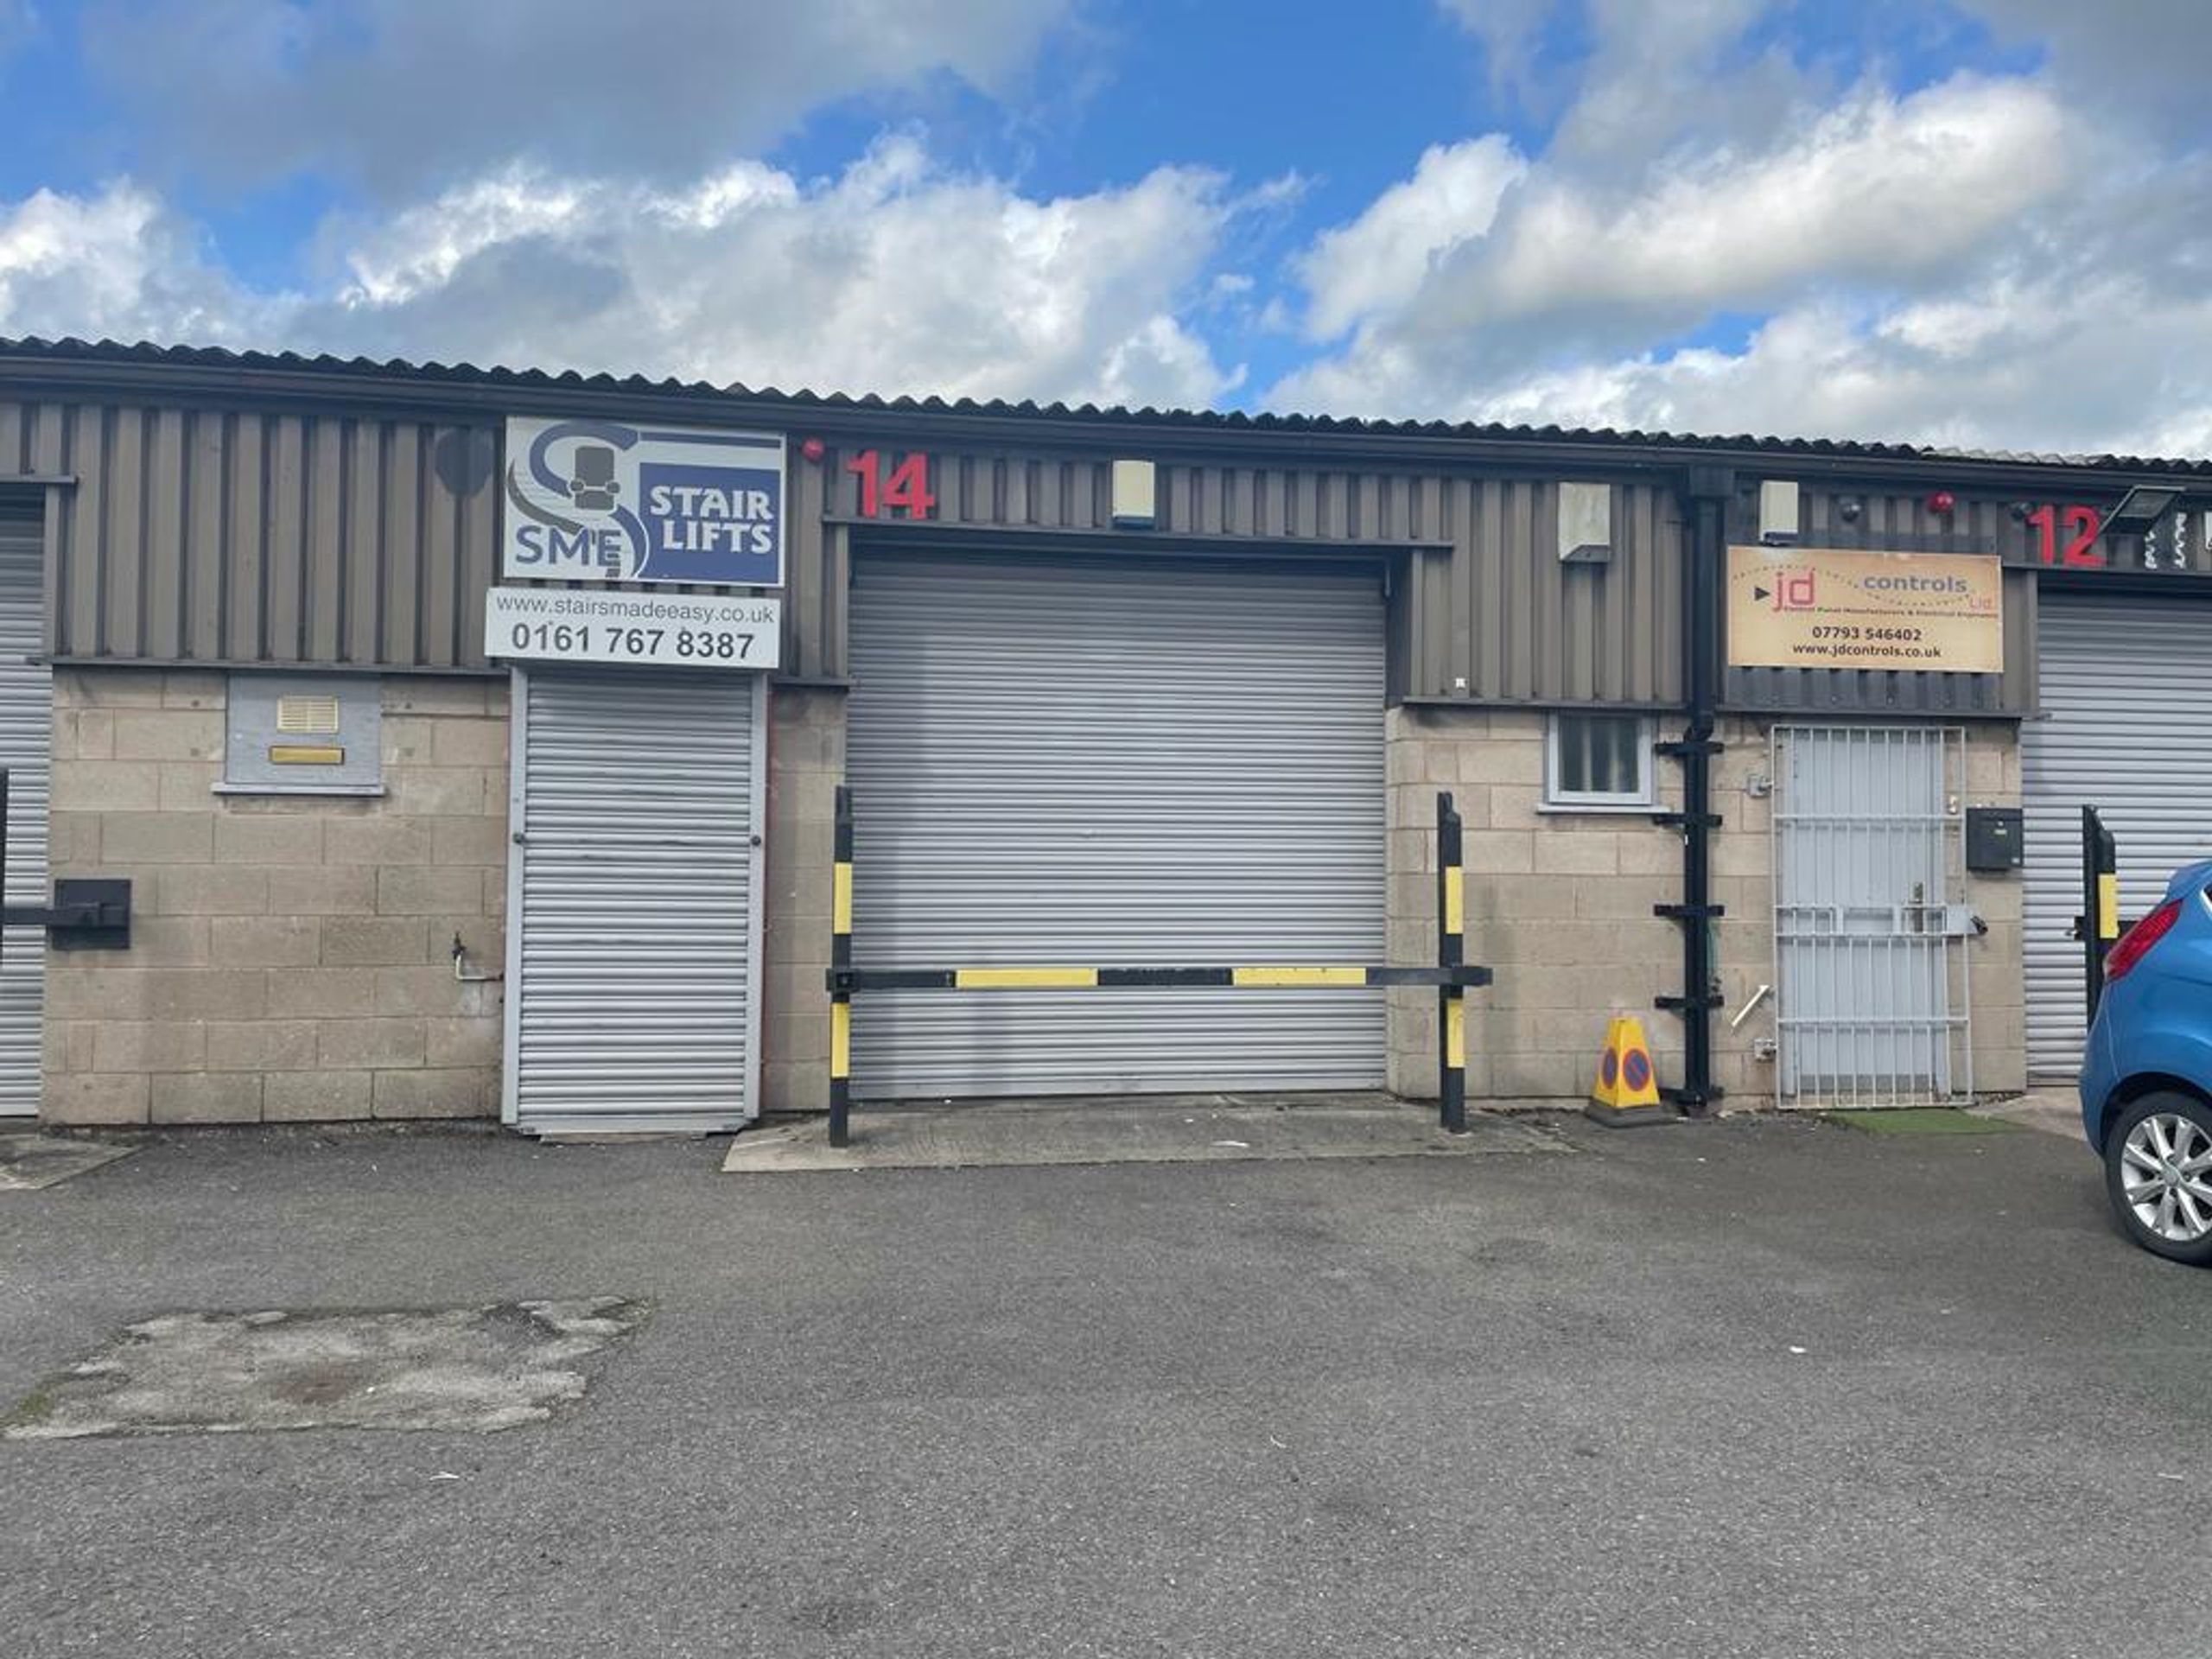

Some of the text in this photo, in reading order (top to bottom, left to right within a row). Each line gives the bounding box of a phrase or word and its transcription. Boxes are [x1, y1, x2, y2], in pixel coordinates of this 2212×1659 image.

[845, 449, 934, 518] 14
[649, 485, 774, 520] STAIR
[662, 519, 773, 554] LIFTS
[2026, 504, 2107, 567] 12
[1773, 568, 1815, 612] jd
[1864, 574, 1968, 593] controls
[497, 594, 774, 625] www.stairsmadeeasy.co.uk
[512, 622, 754, 660] 0161 767 8387
[1793, 643, 1942, 658] www.jdcontrols.co.uk
[1812, 626, 1923, 641] 07793 546402
